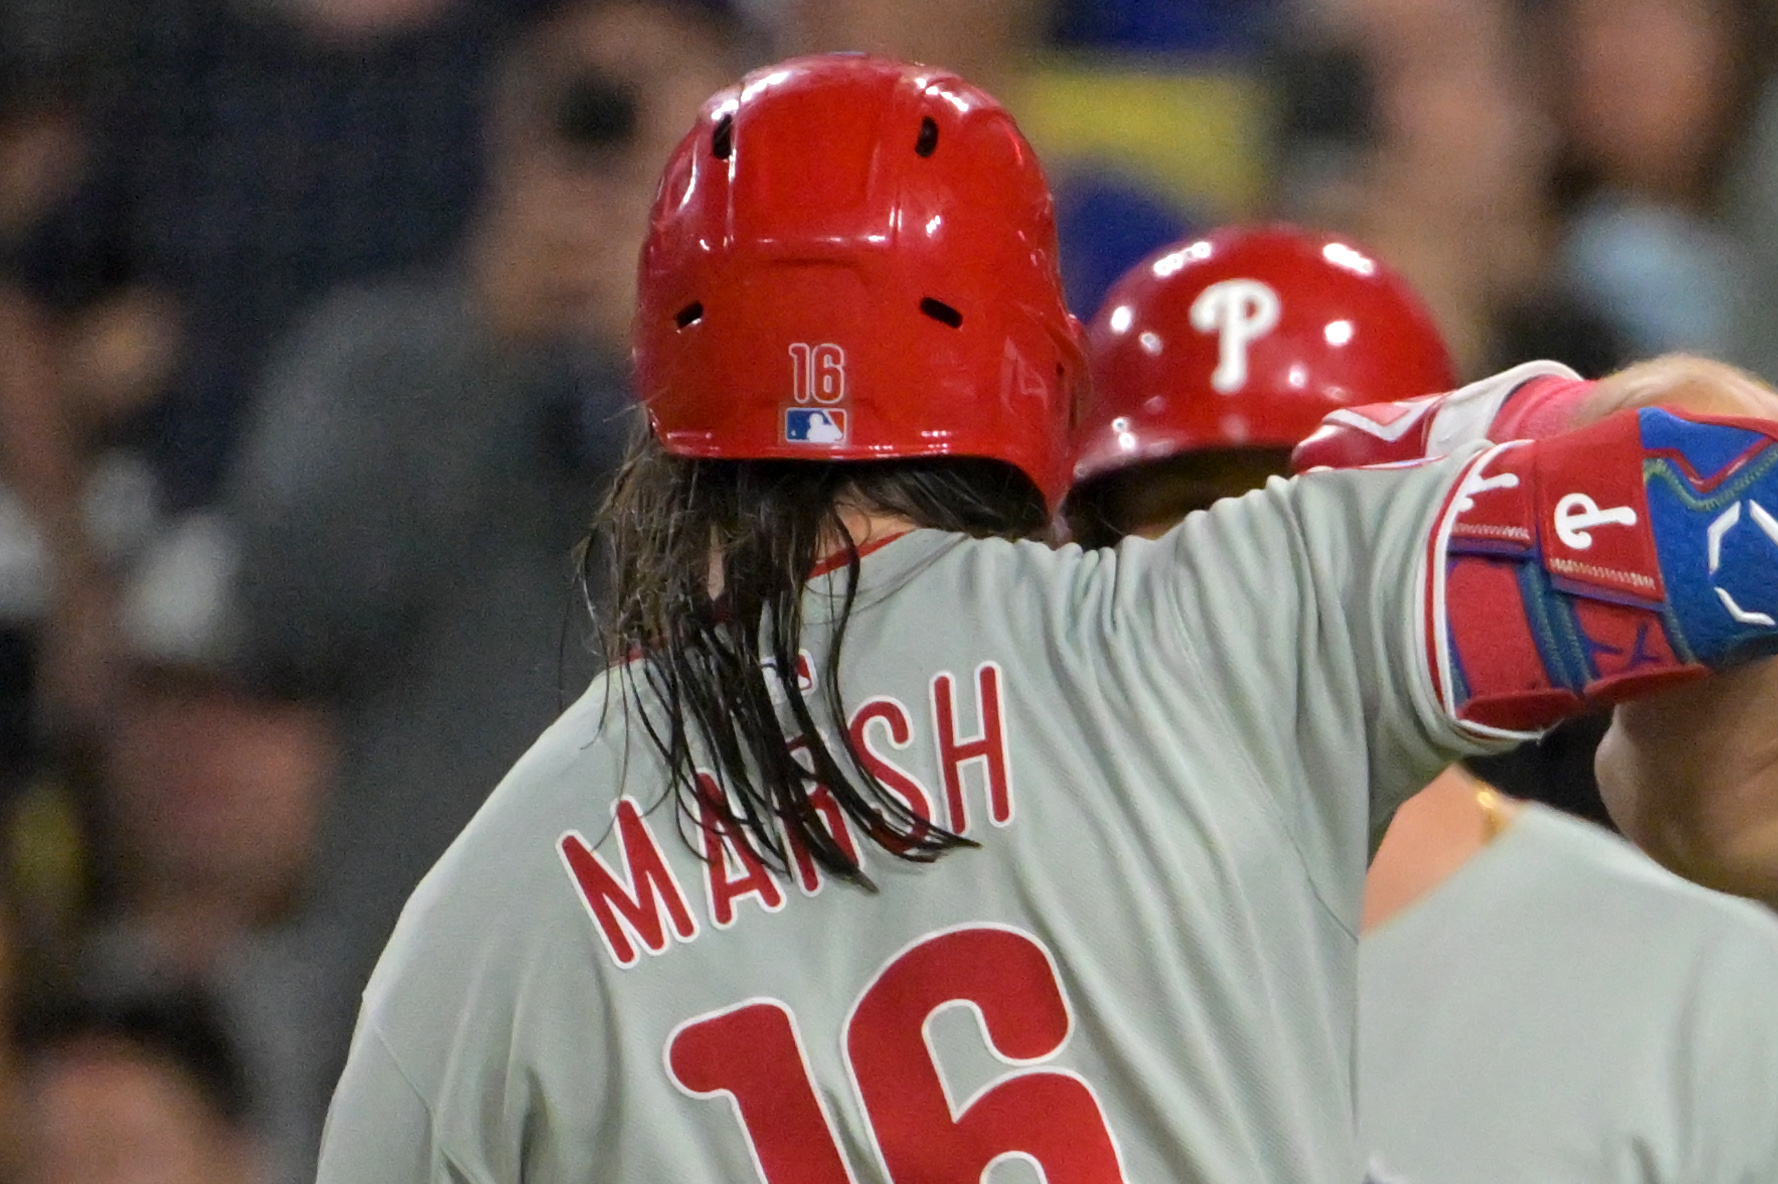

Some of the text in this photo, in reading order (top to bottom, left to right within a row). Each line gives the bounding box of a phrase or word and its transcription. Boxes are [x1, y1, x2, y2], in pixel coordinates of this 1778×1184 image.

[1189, 278, 1283, 394] P
[788, 342, 845, 404] 16
[1553, 492, 1639, 550] P
